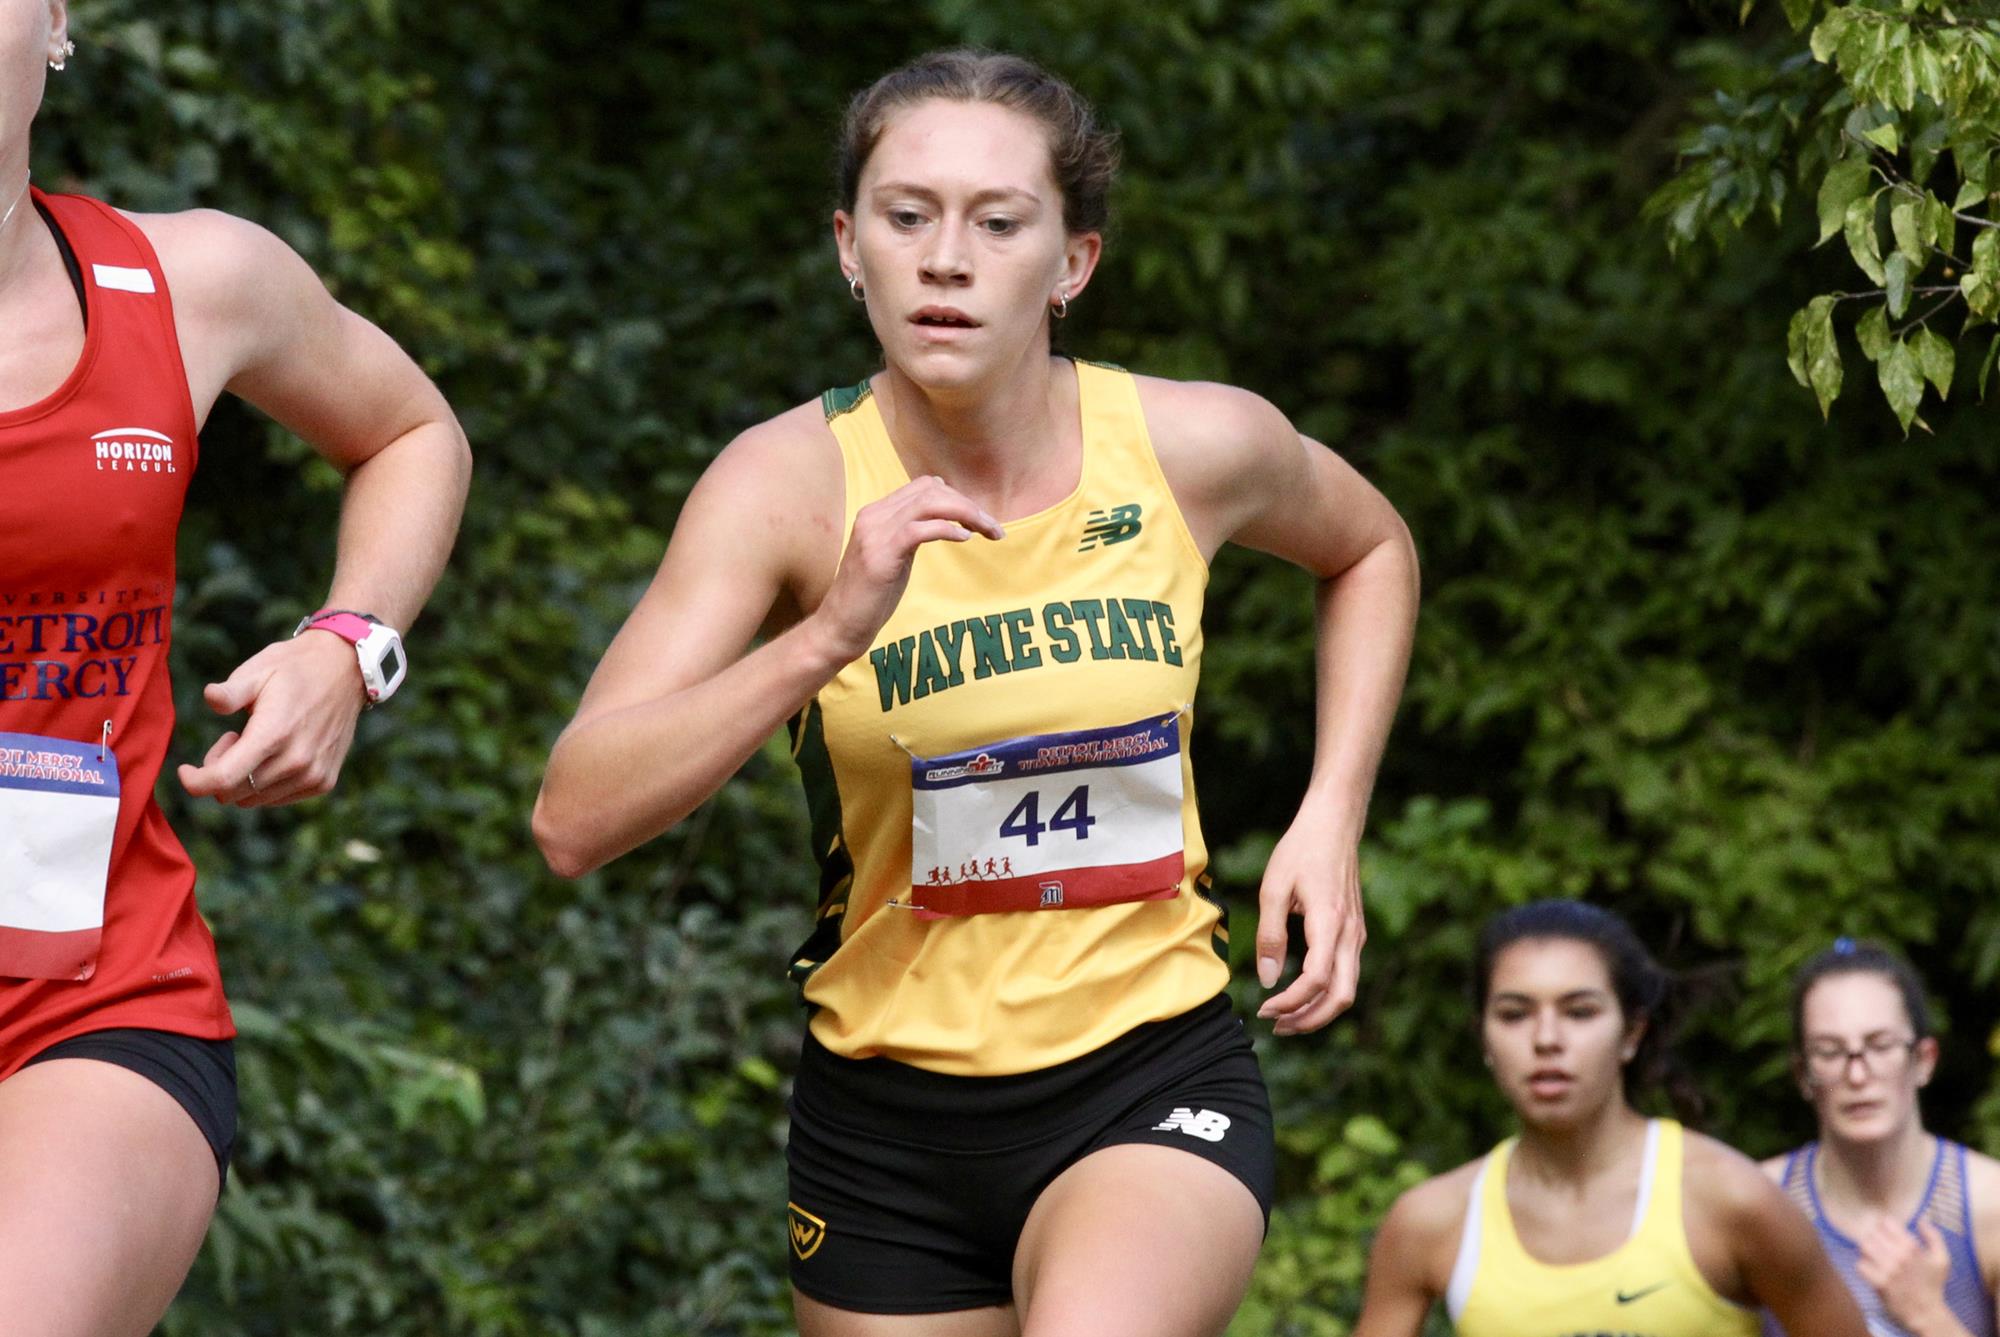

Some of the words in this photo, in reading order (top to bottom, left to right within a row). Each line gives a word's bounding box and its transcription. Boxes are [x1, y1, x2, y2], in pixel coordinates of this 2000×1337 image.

[95, 442, 172, 461] HORIZON
[869, 608, 1043, 713] WAYNE
[1042, 598, 1184, 668] STATE
[1037, 741, 1101, 759] DETROIT
[1103, 730, 1151, 750] MERCY
[1071, 737, 1169, 764] INVITATIONAL
[26, 751, 83, 768] MERCY
[999, 785, 1096, 847] 44
